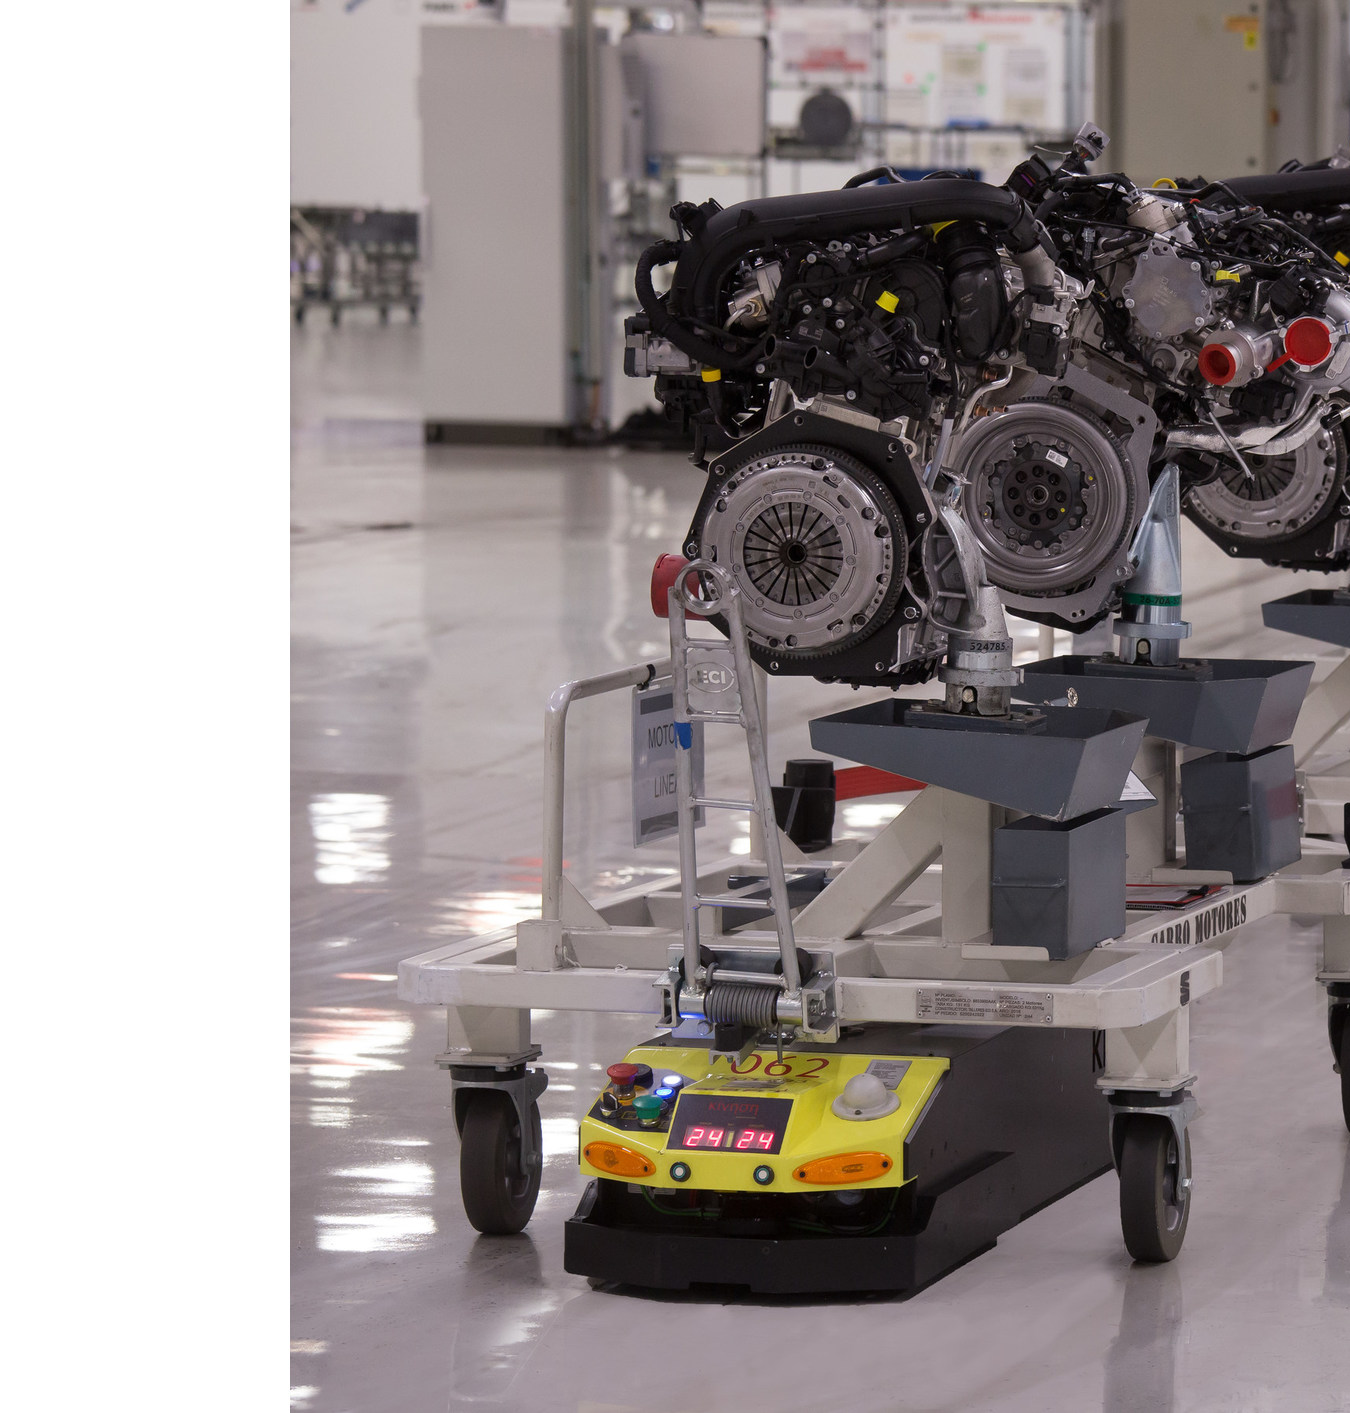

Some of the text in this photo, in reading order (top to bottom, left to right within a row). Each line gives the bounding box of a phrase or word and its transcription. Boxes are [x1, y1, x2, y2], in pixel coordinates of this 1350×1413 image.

[696, 669, 726, 684] ECI
[648, 723, 693, 749] MOTO
[1195, 894, 1247, 944] MOTORES
[730, 1053, 830, 1079] 062
[685, 1128, 775, 1150] 24 24
